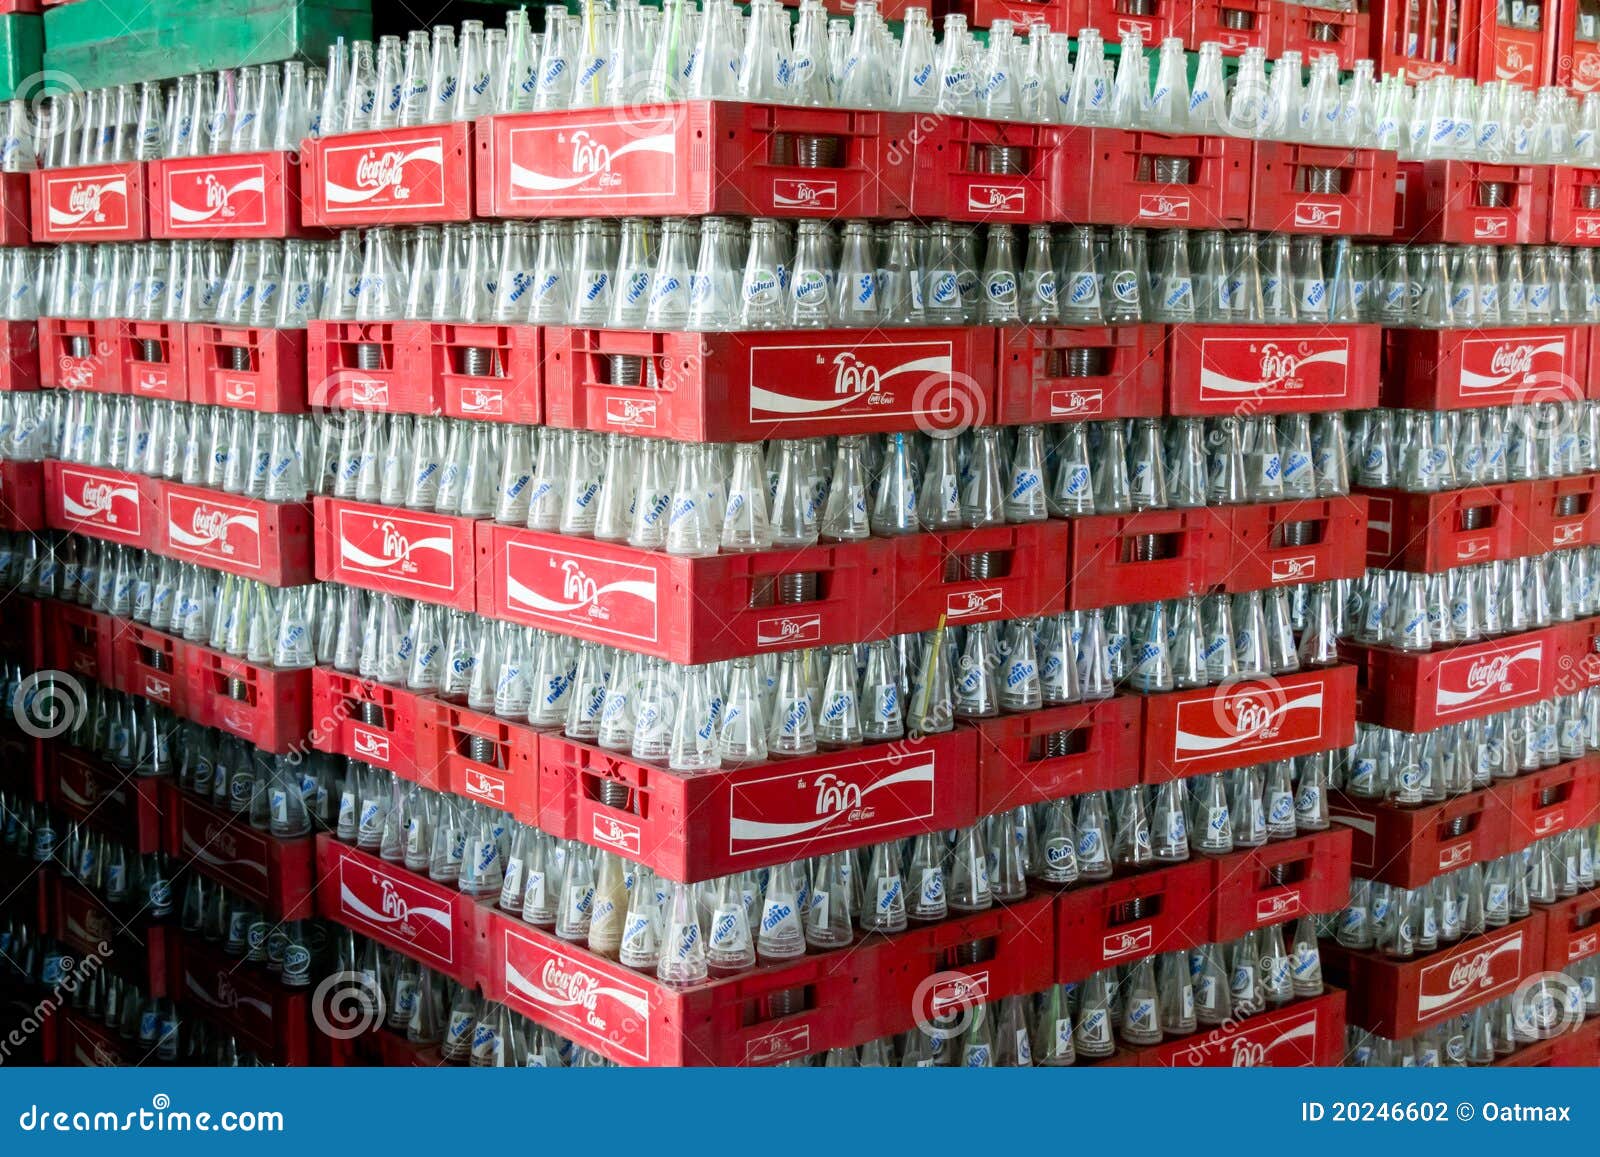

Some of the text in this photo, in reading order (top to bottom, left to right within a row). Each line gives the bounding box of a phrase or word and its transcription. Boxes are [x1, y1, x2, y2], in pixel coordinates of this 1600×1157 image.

[571, 131, 611, 173] โค้ก
[833, 352, 880, 394] โค้ก
[1262, 343, 1295, 378] โค้ก
[576, 482, 598, 508] Fanta
[644, 495, 670, 525] Fanta
[382, 521, 409, 560] โค้ก
[561, 560, 598, 605] โค้ก
[1007, 664, 1034, 688] Fanta
[825, 695, 851, 721] แฟนต้า
[814, 774, 861, 814] โค้ก
[381, 880, 408, 922] โค้ก
[763, 904, 791, 932] Fanta
[713, 913, 736, 945] แฟนต้า
[542, 959, 598, 1010] Coca-Cola
